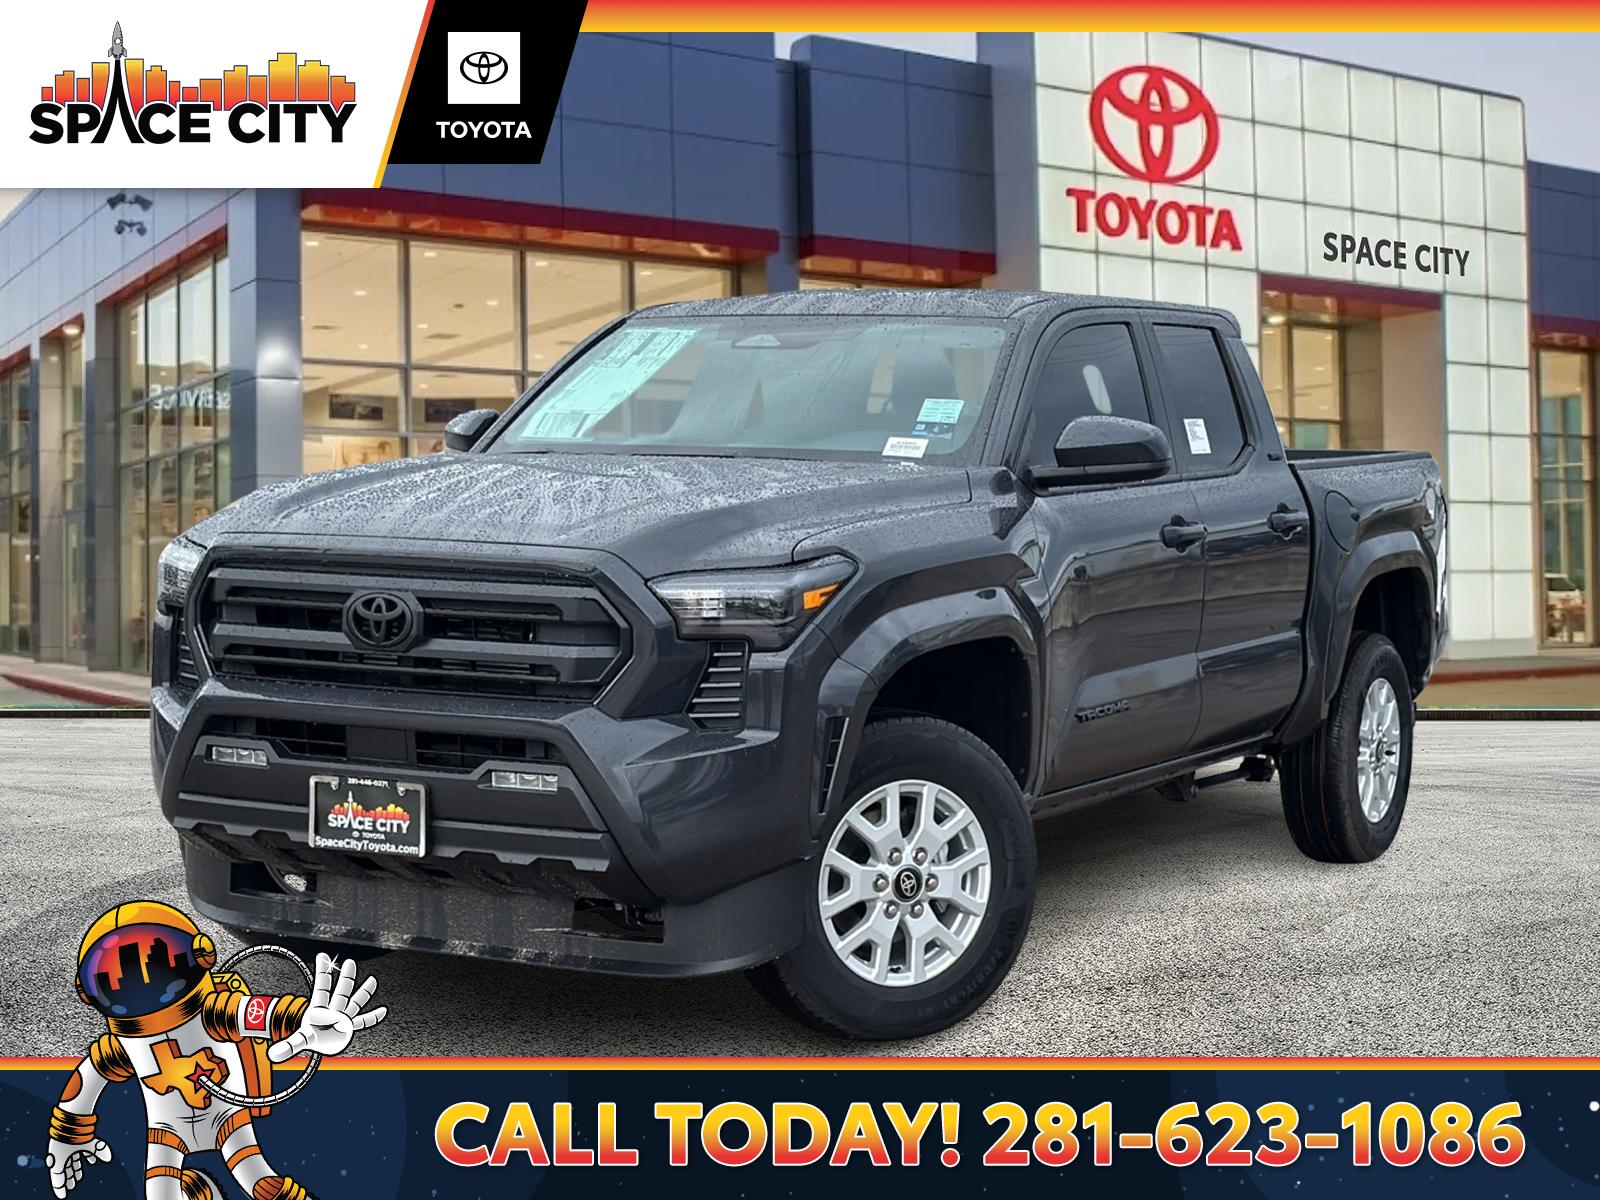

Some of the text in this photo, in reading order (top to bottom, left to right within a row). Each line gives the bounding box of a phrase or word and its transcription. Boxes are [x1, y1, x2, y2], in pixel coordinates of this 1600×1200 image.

[1066, 187, 1243, 252] TOYOTA
[1323, 232, 1470, 277] SPACE CITY
[376, 817, 411, 834] CITY
[315, 836, 419, 855] SpaceCityToyota.com
[362, 832, 386, 840] TOYOTA
